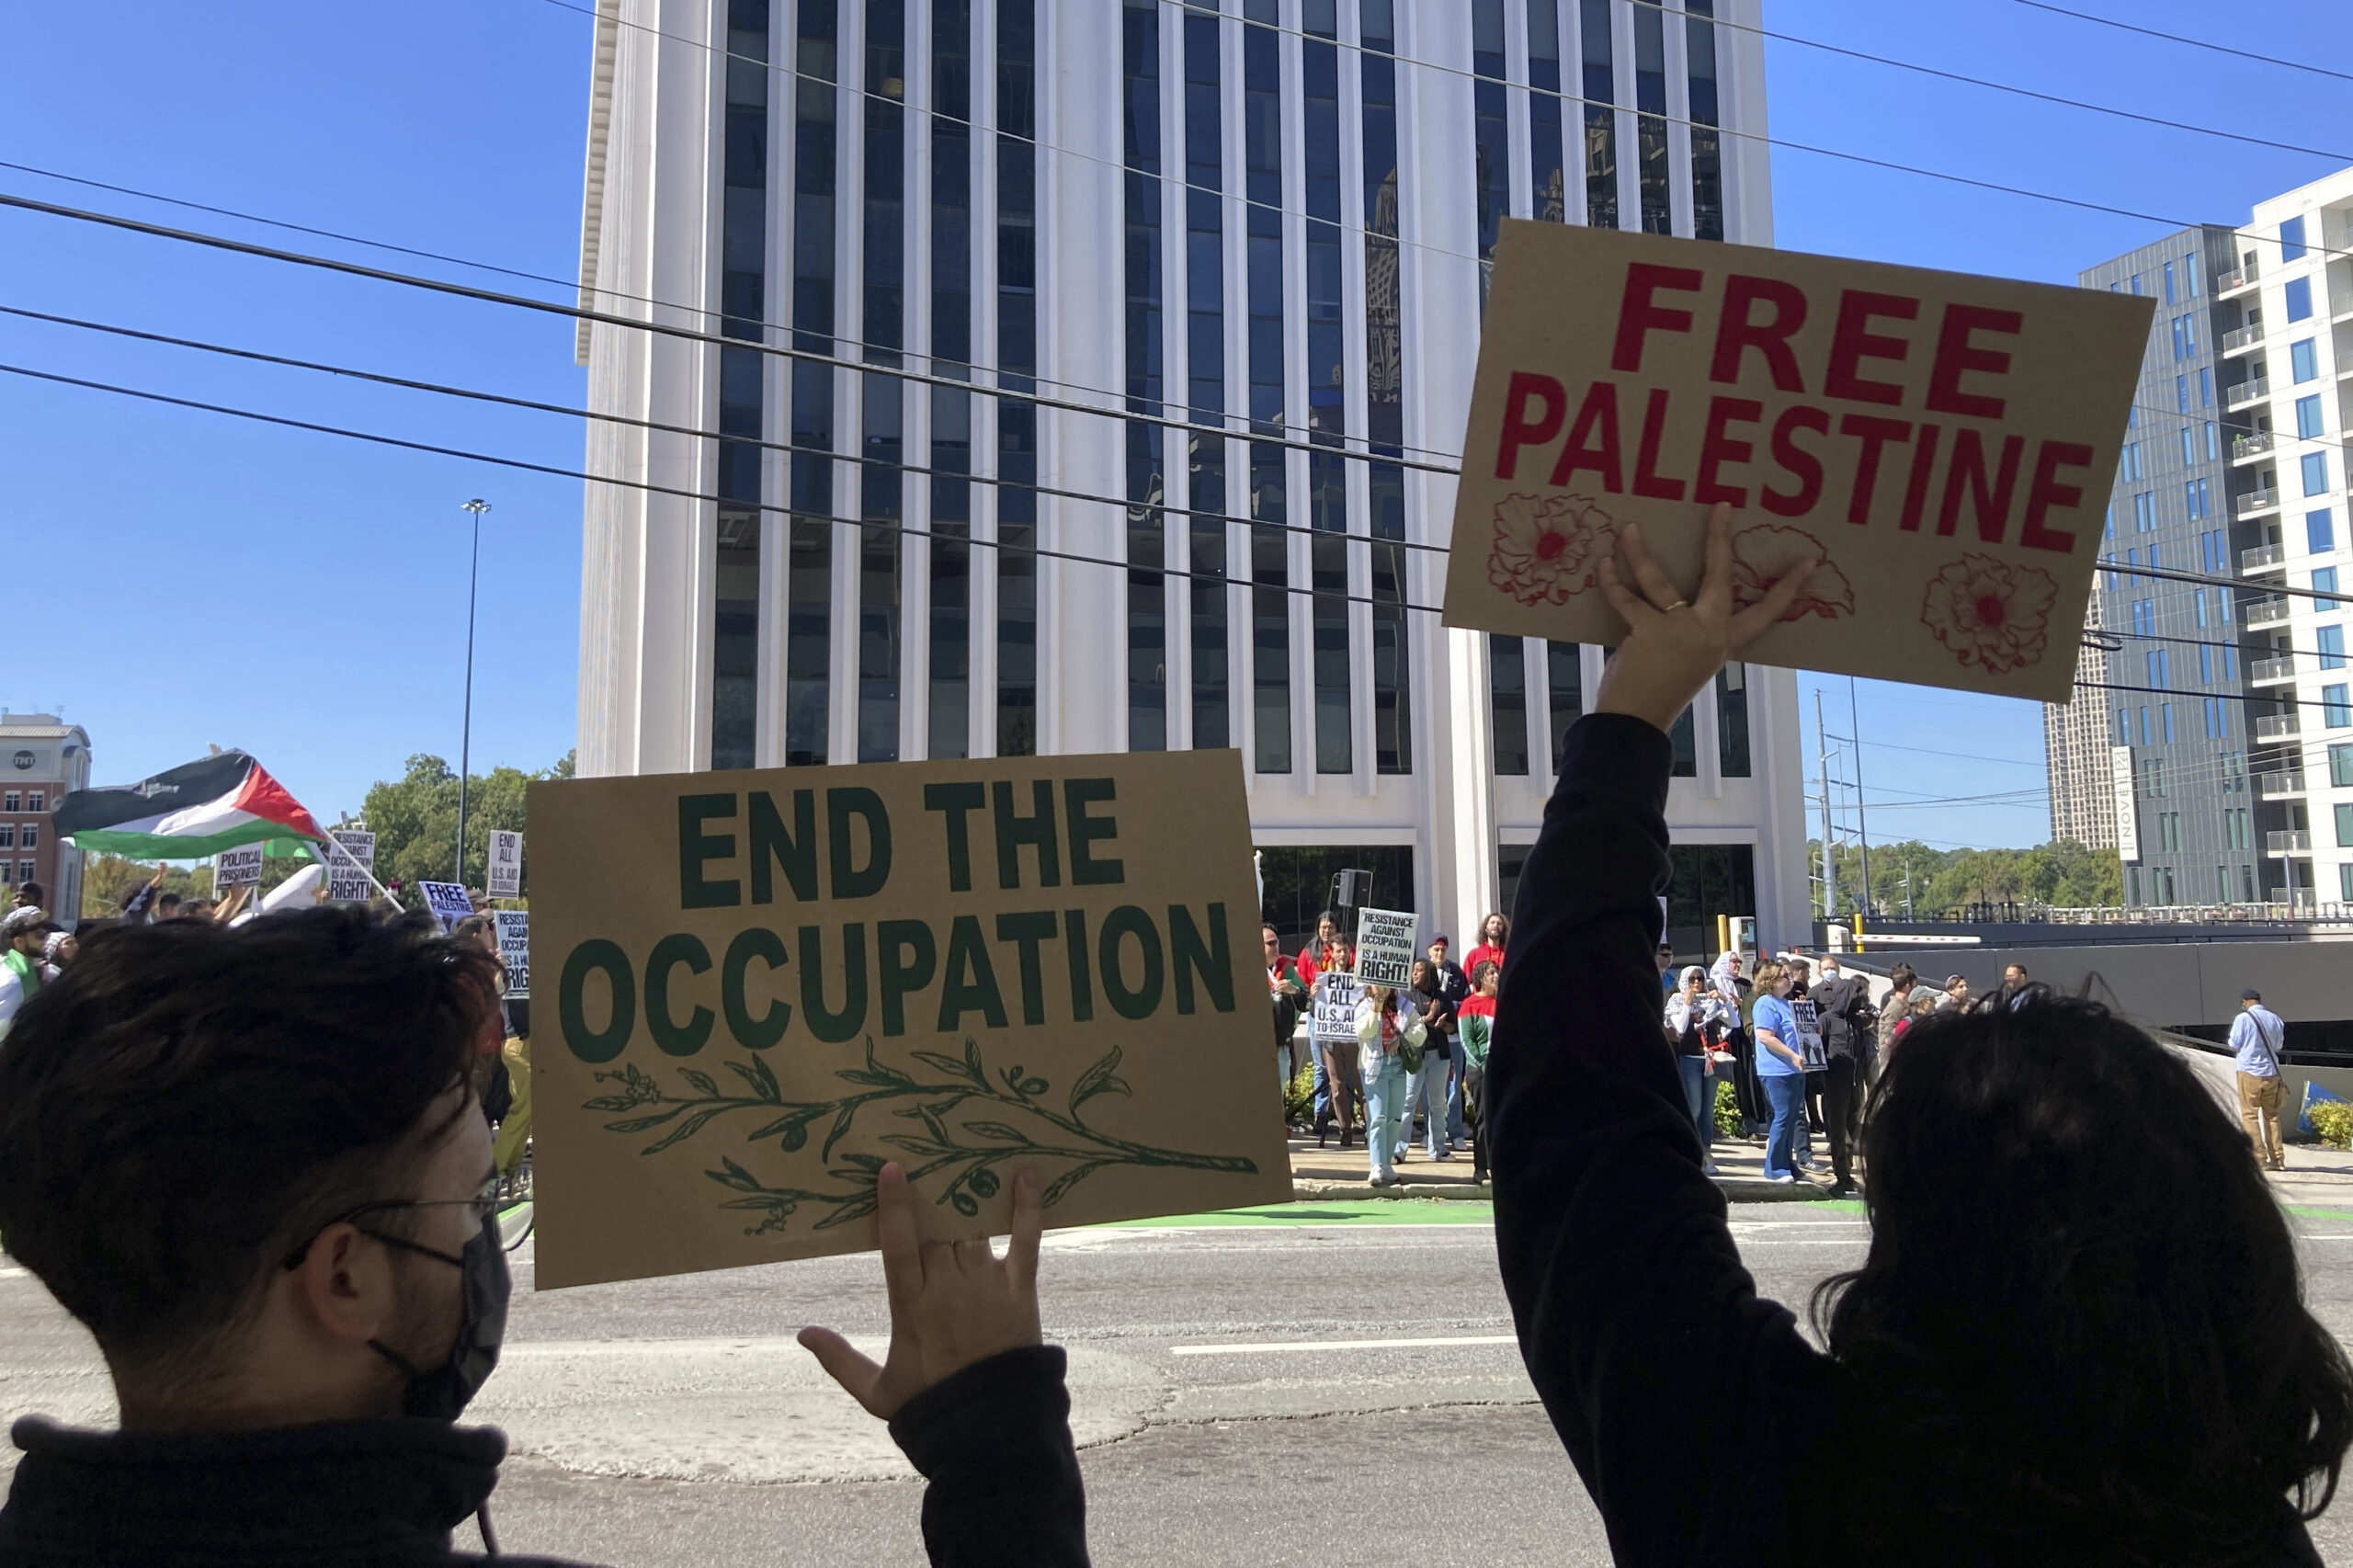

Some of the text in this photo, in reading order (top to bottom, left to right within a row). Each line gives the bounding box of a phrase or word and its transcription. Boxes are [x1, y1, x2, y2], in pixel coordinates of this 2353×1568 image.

[1609, 262, 2024, 420] FREE
[1495, 370, 2094, 553] PALESTINE
[2119, 774, 2131, 837] NOVEL
[499, 833, 516, 848] END
[678, 778, 1126, 910] END THE
[221, 850, 261, 868] POLITICAL
[331, 856, 372, 867] OCCUPTION
[499, 848, 512, 862] ALL
[219, 866, 261, 881] PRISONERS
[332, 869, 339, 880] IS
[340, 869, 346, 880] A
[492, 867, 517, 881] U.S. AID
[331, 881, 371, 900] RIGHT!
[426, 883, 467, 902] FREE
[491, 880, 498, 890] TO
[432, 902, 473, 913] PALESTINE
[1364, 913, 1414, 928] RESISTANCE
[1370, 924, 1406, 937] AGAINST
[502, 939, 529, 951] OCCUP
[1361, 934, 1412, 949] OCCUPATION
[1362, 949, 1410, 964] IS A HUMAN
[1360, 960, 1408, 982] RIGHT!
[558, 902, 1237, 1064] OCCUPATION
[1327, 974, 1355, 990] END
[1329, 990, 1352, 1006] ALL
[1318, 1008, 1340, 1022] U.S.
[1793, 1003, 1816, 1022] FREE
[1317, 1022, 1327, 1032] TO
